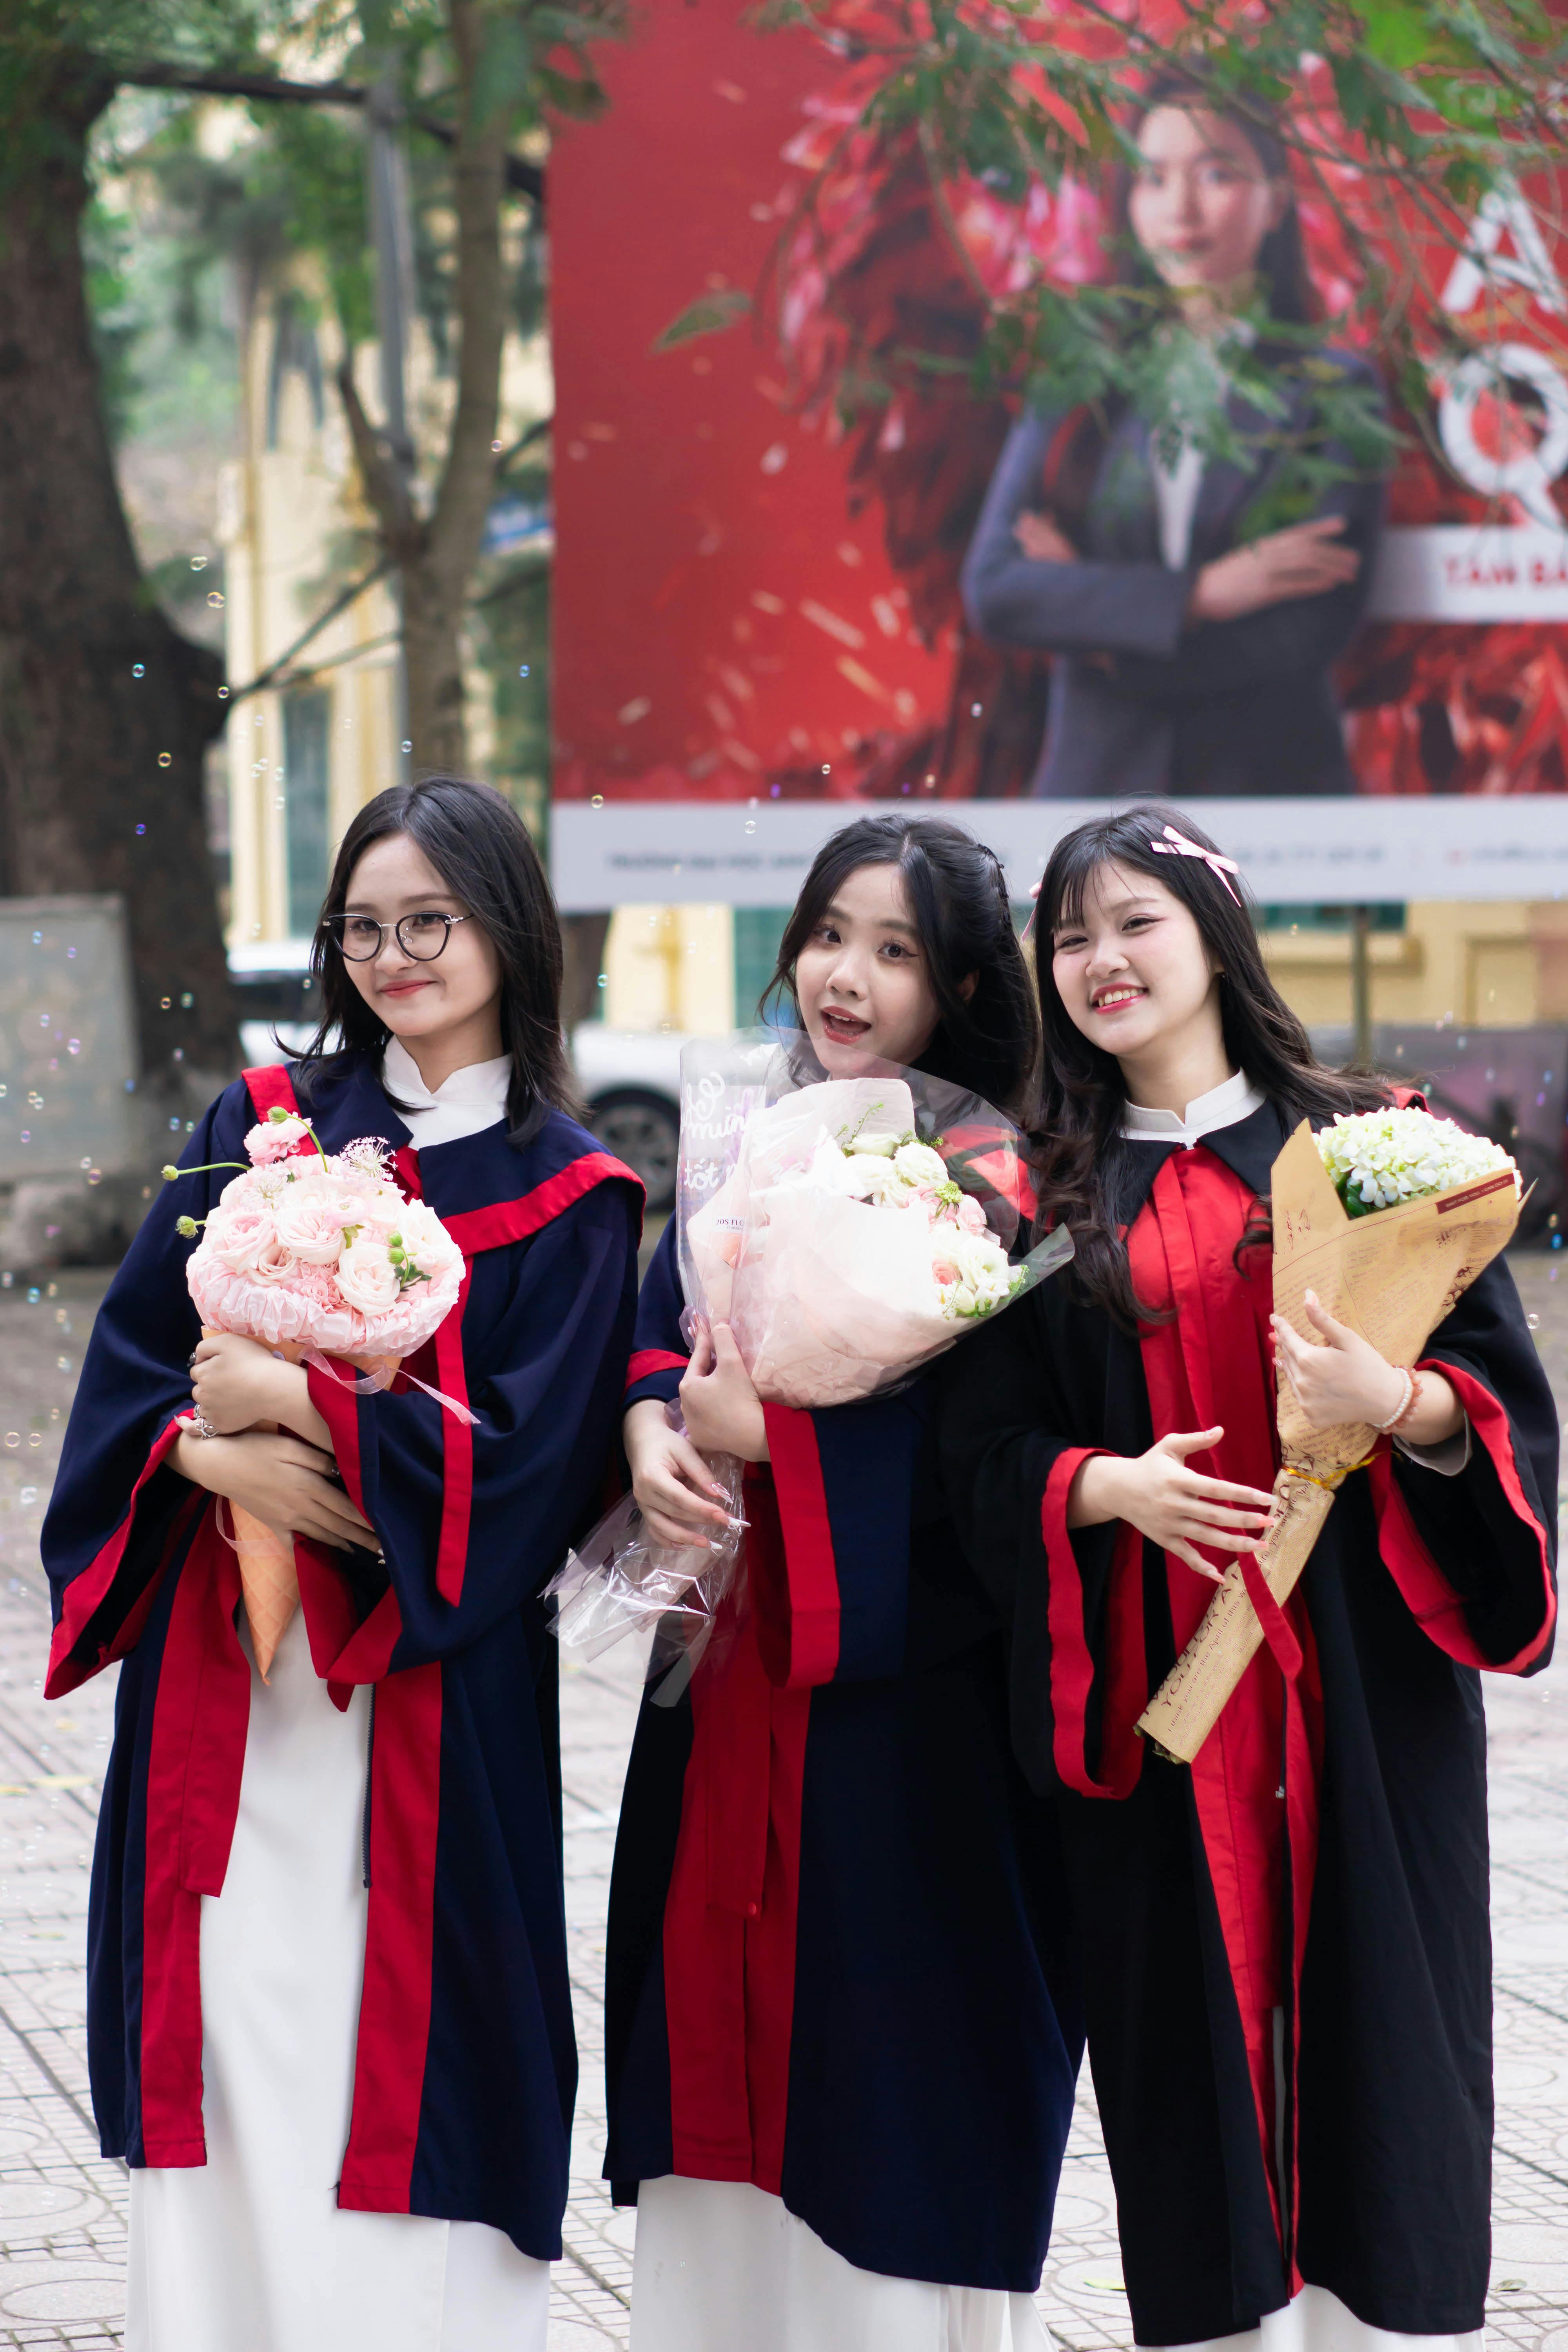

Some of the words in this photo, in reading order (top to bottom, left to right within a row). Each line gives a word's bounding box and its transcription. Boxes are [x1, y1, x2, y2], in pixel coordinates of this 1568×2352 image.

[1170, 1704, 1184, 1726] think
[1181, 1685, 1192, 1703] you
[1191, 1668, 1201, 1684] are
[1199, 1651, 1211, 1666] the
[1209, 1628, 1223, 1650] April
[1219, 1617, 1230, 1628] of
[1226, 1599, 1240, 1617] this
